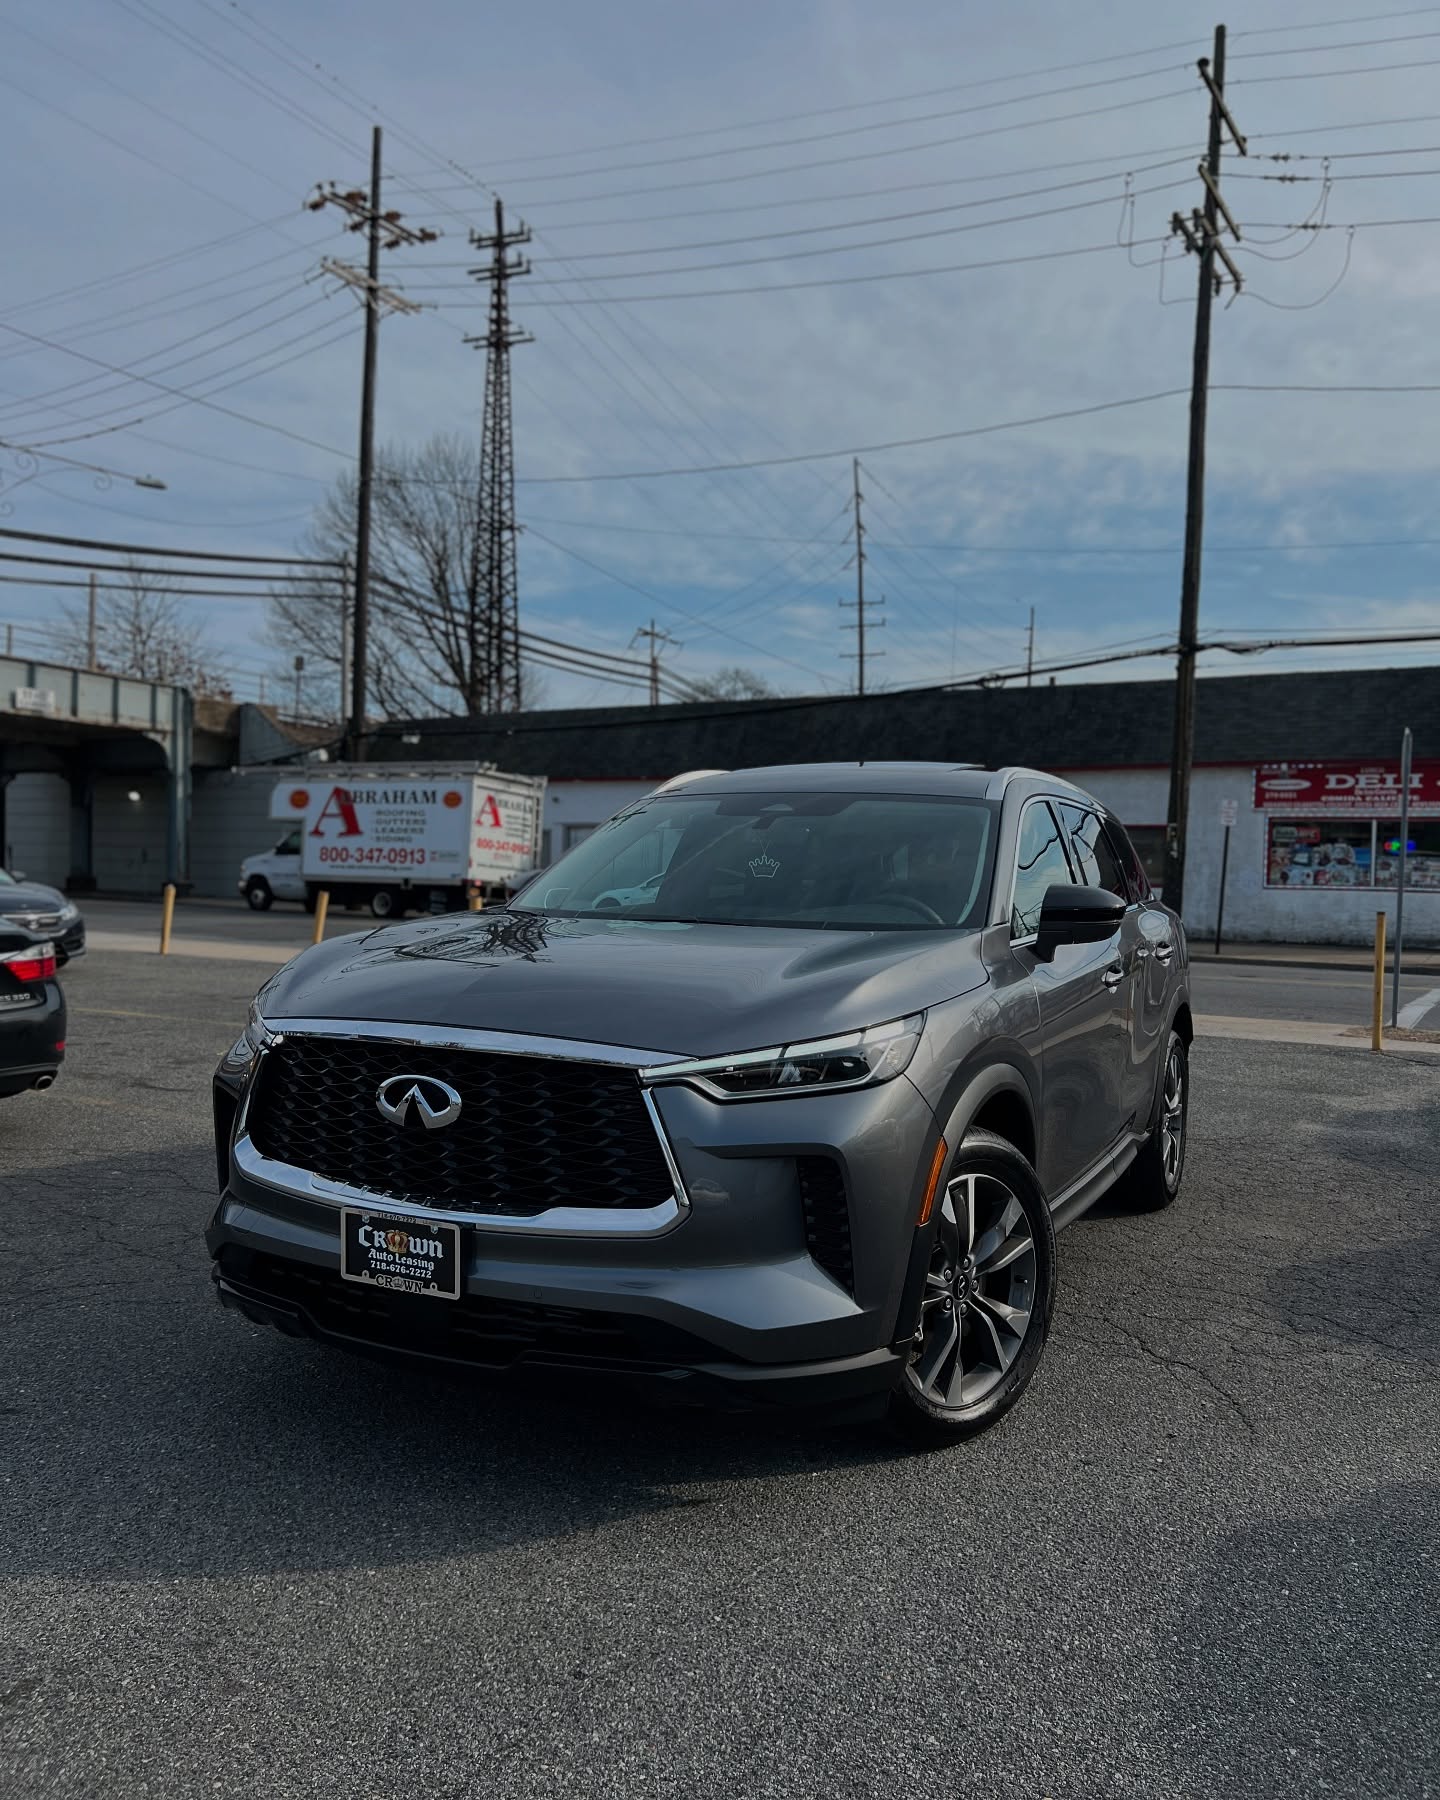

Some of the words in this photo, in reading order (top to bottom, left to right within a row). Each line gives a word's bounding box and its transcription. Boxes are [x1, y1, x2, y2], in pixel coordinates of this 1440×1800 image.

[1324, 773, 1423, 789] DELI
[320, 846, 426, 865] 800-347-0913
[368, 1248, 394, 1261] Auto
[395, 1253, 435, 1271] Leasing
[370, 1260, 432, 1279] 718-676-7272
